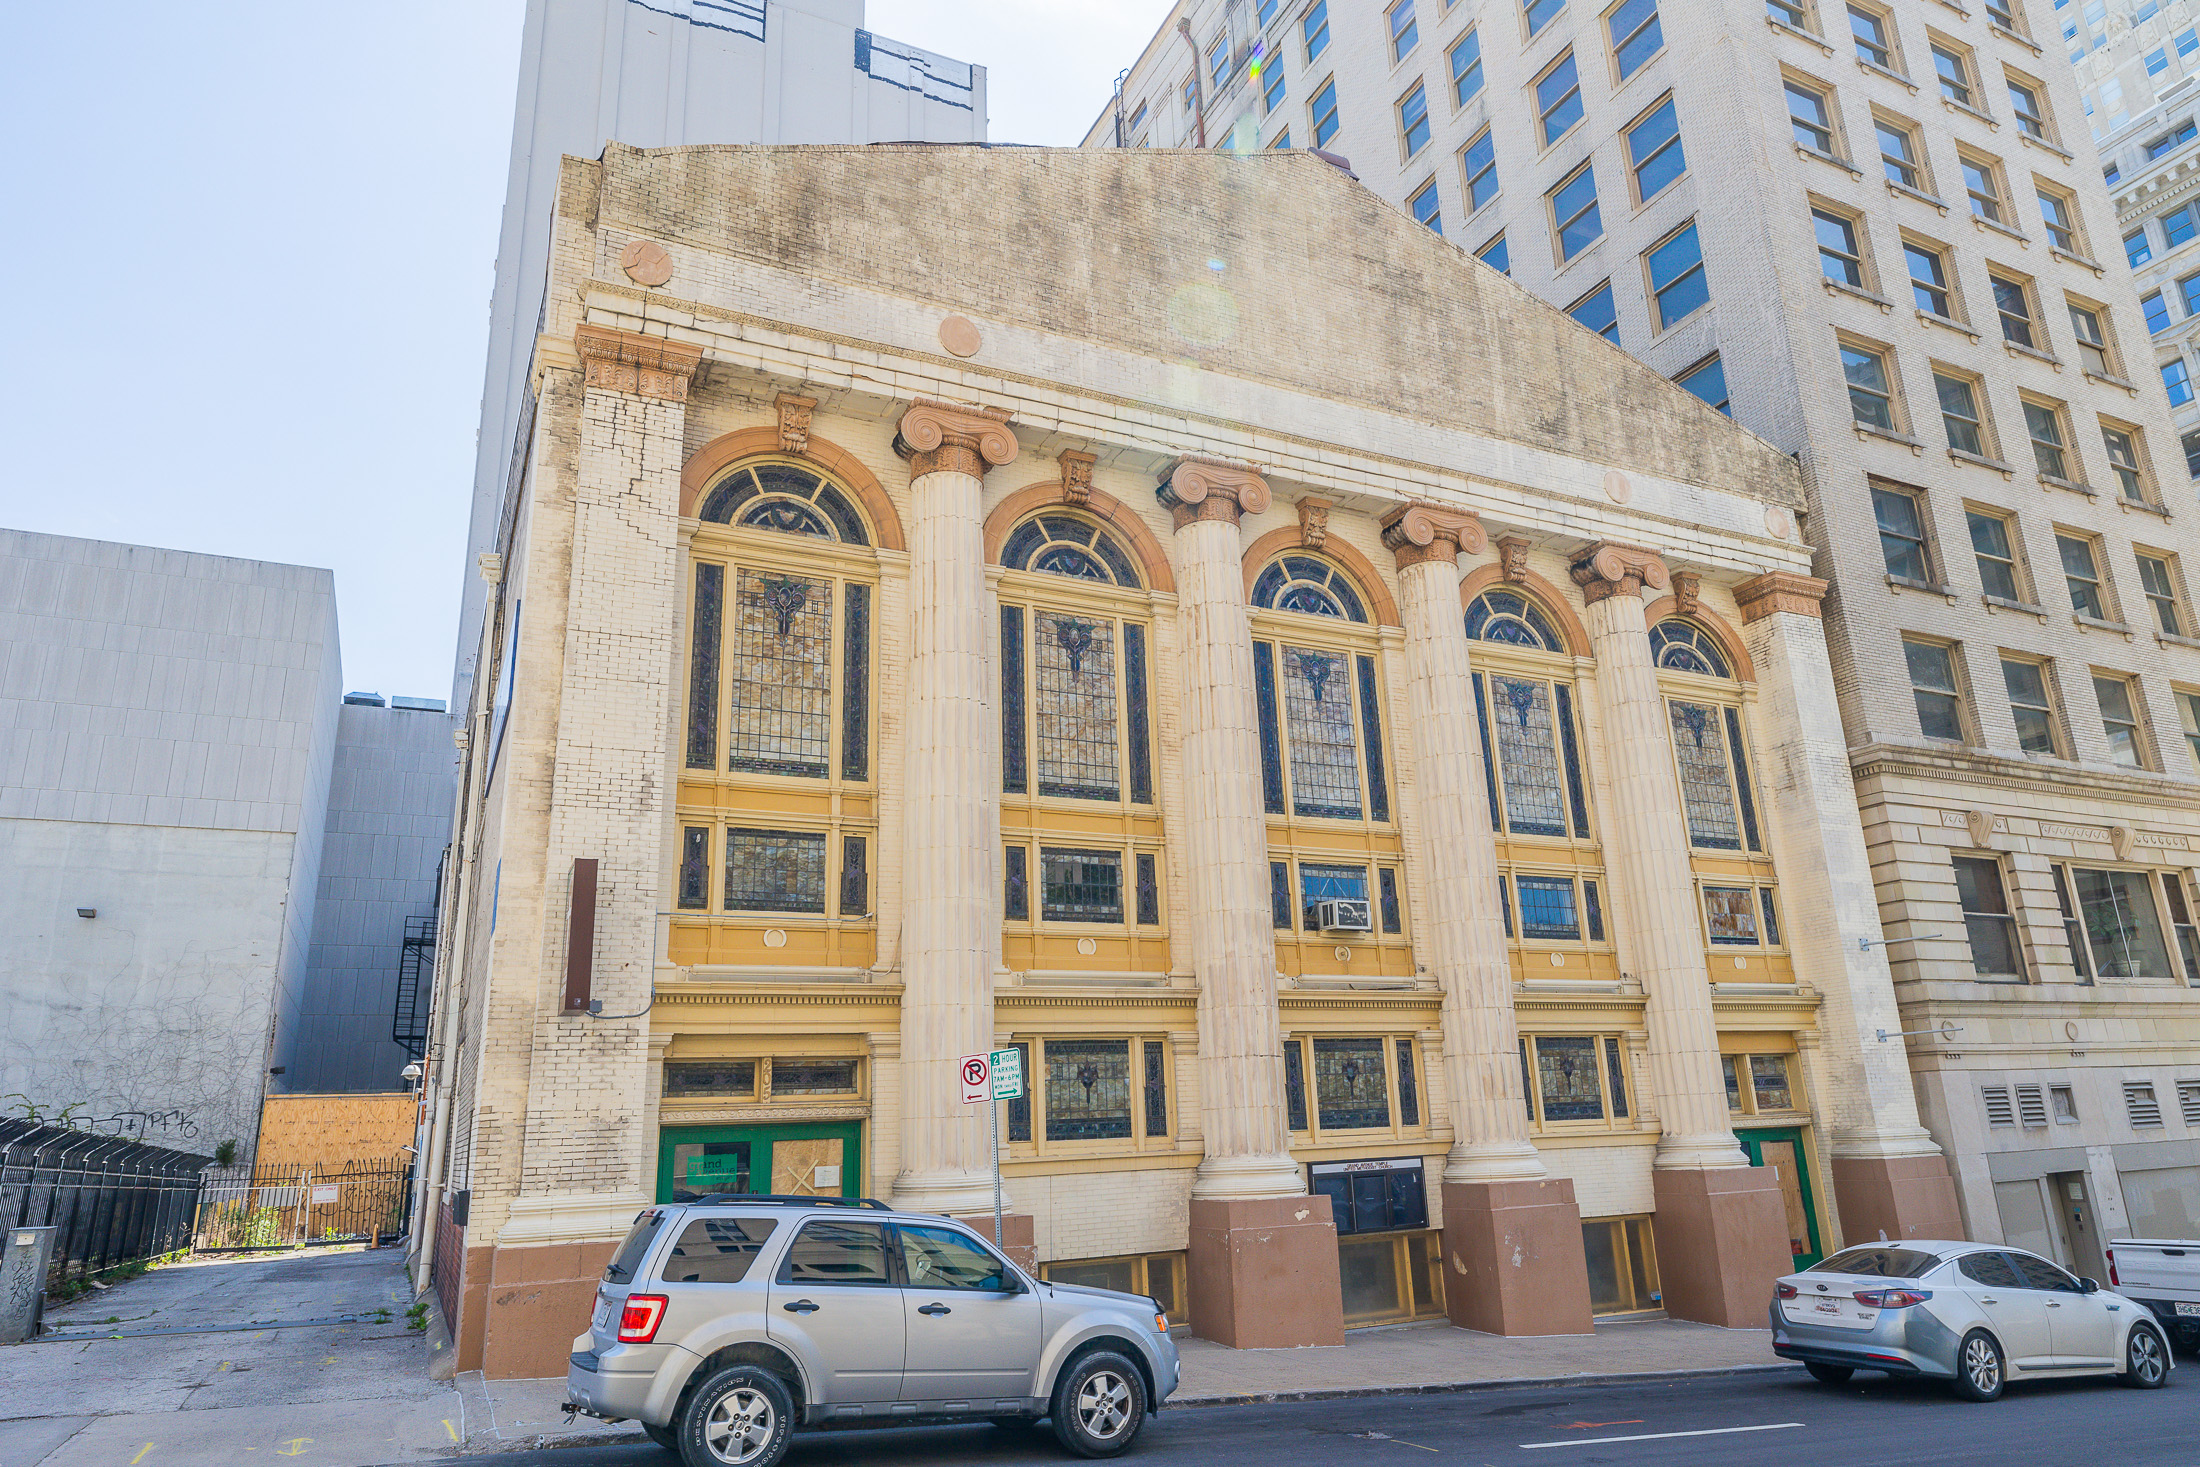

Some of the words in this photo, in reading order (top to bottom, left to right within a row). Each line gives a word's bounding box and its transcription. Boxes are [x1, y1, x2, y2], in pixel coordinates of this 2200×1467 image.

[993, 1055, 999, 1065] 2
[1002, 1053, 1017, 1063] HOUR
[994, 1065, 1018, 1074] PARKING
[763, 1059, 771, 1100] 205
[994, 1073, 1020, 1083] 7AM-6PM
[689, 1159, 722, 1172] grand
[695, 1377, 743, 1446] DESTINATION
